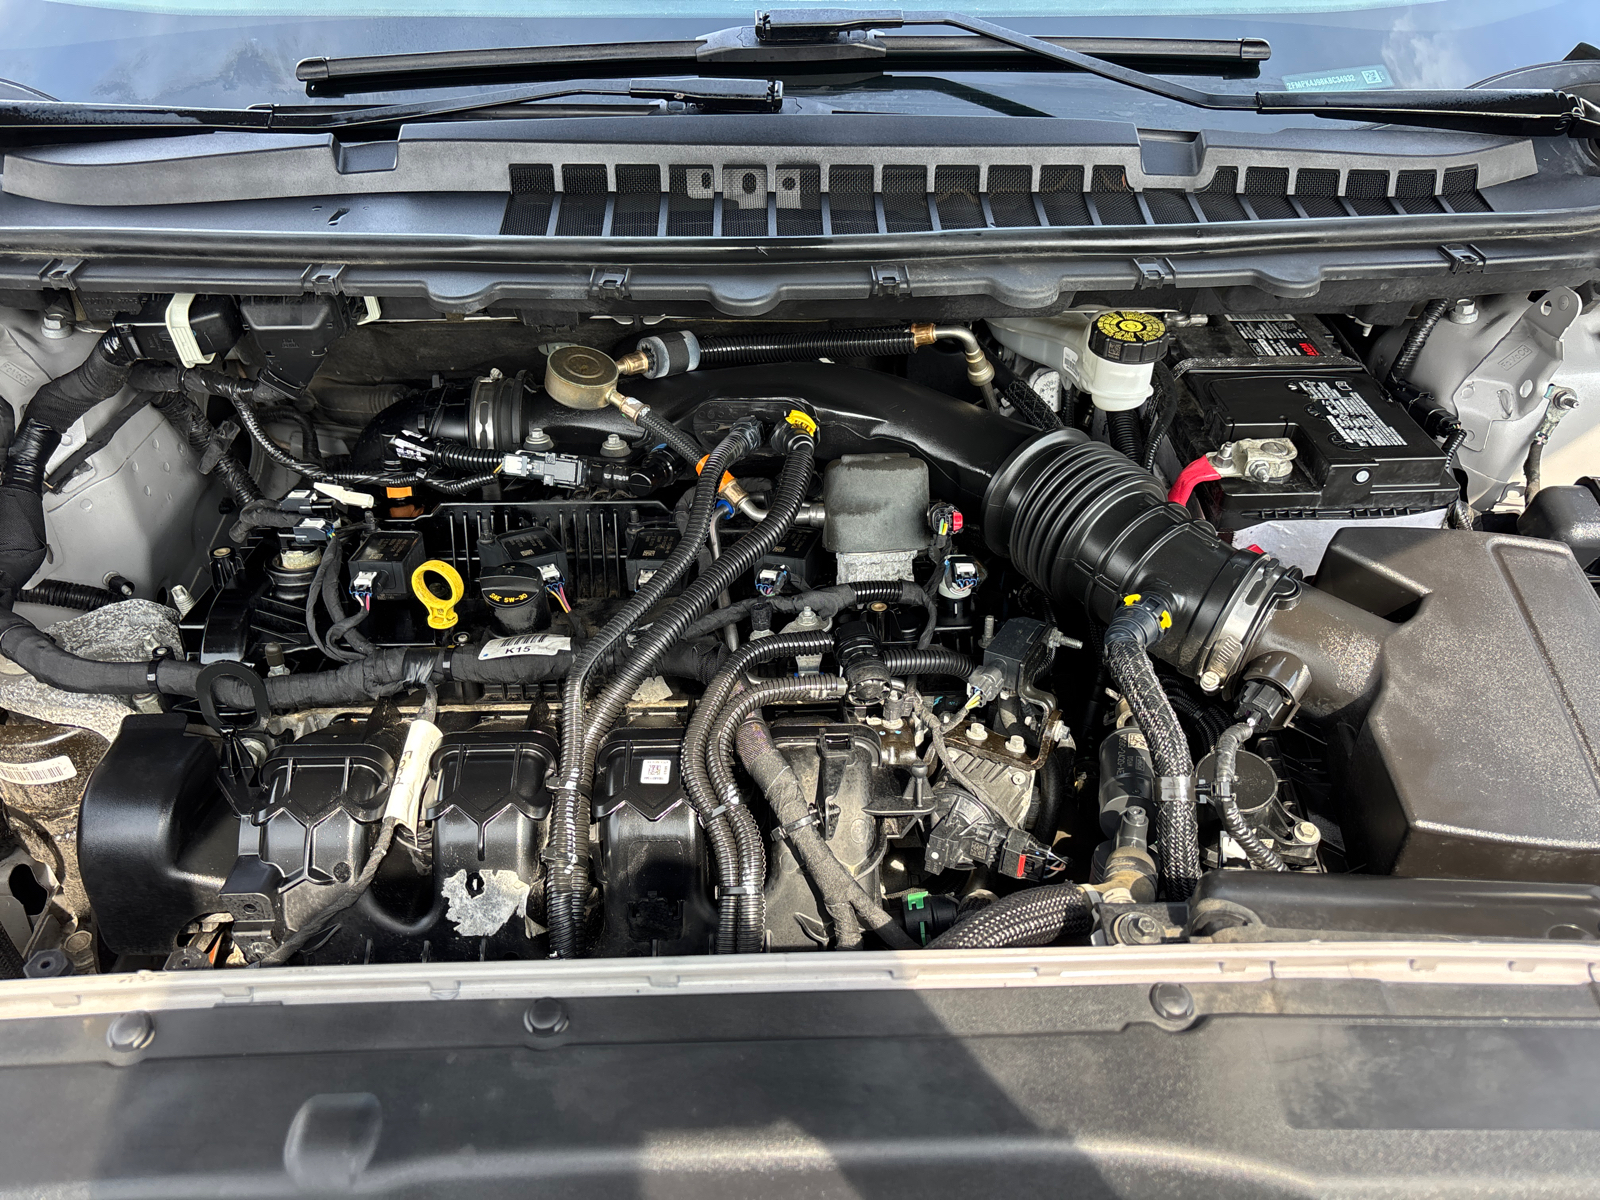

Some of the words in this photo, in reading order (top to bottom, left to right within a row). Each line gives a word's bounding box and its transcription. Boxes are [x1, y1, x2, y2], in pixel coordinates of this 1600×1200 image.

[1299, 343, 1317, 356] AGM
[489, 593, 502, 602] SAE
[503, 593, 528, 603] 5W-30
[505, 645, 531, 654] K15
